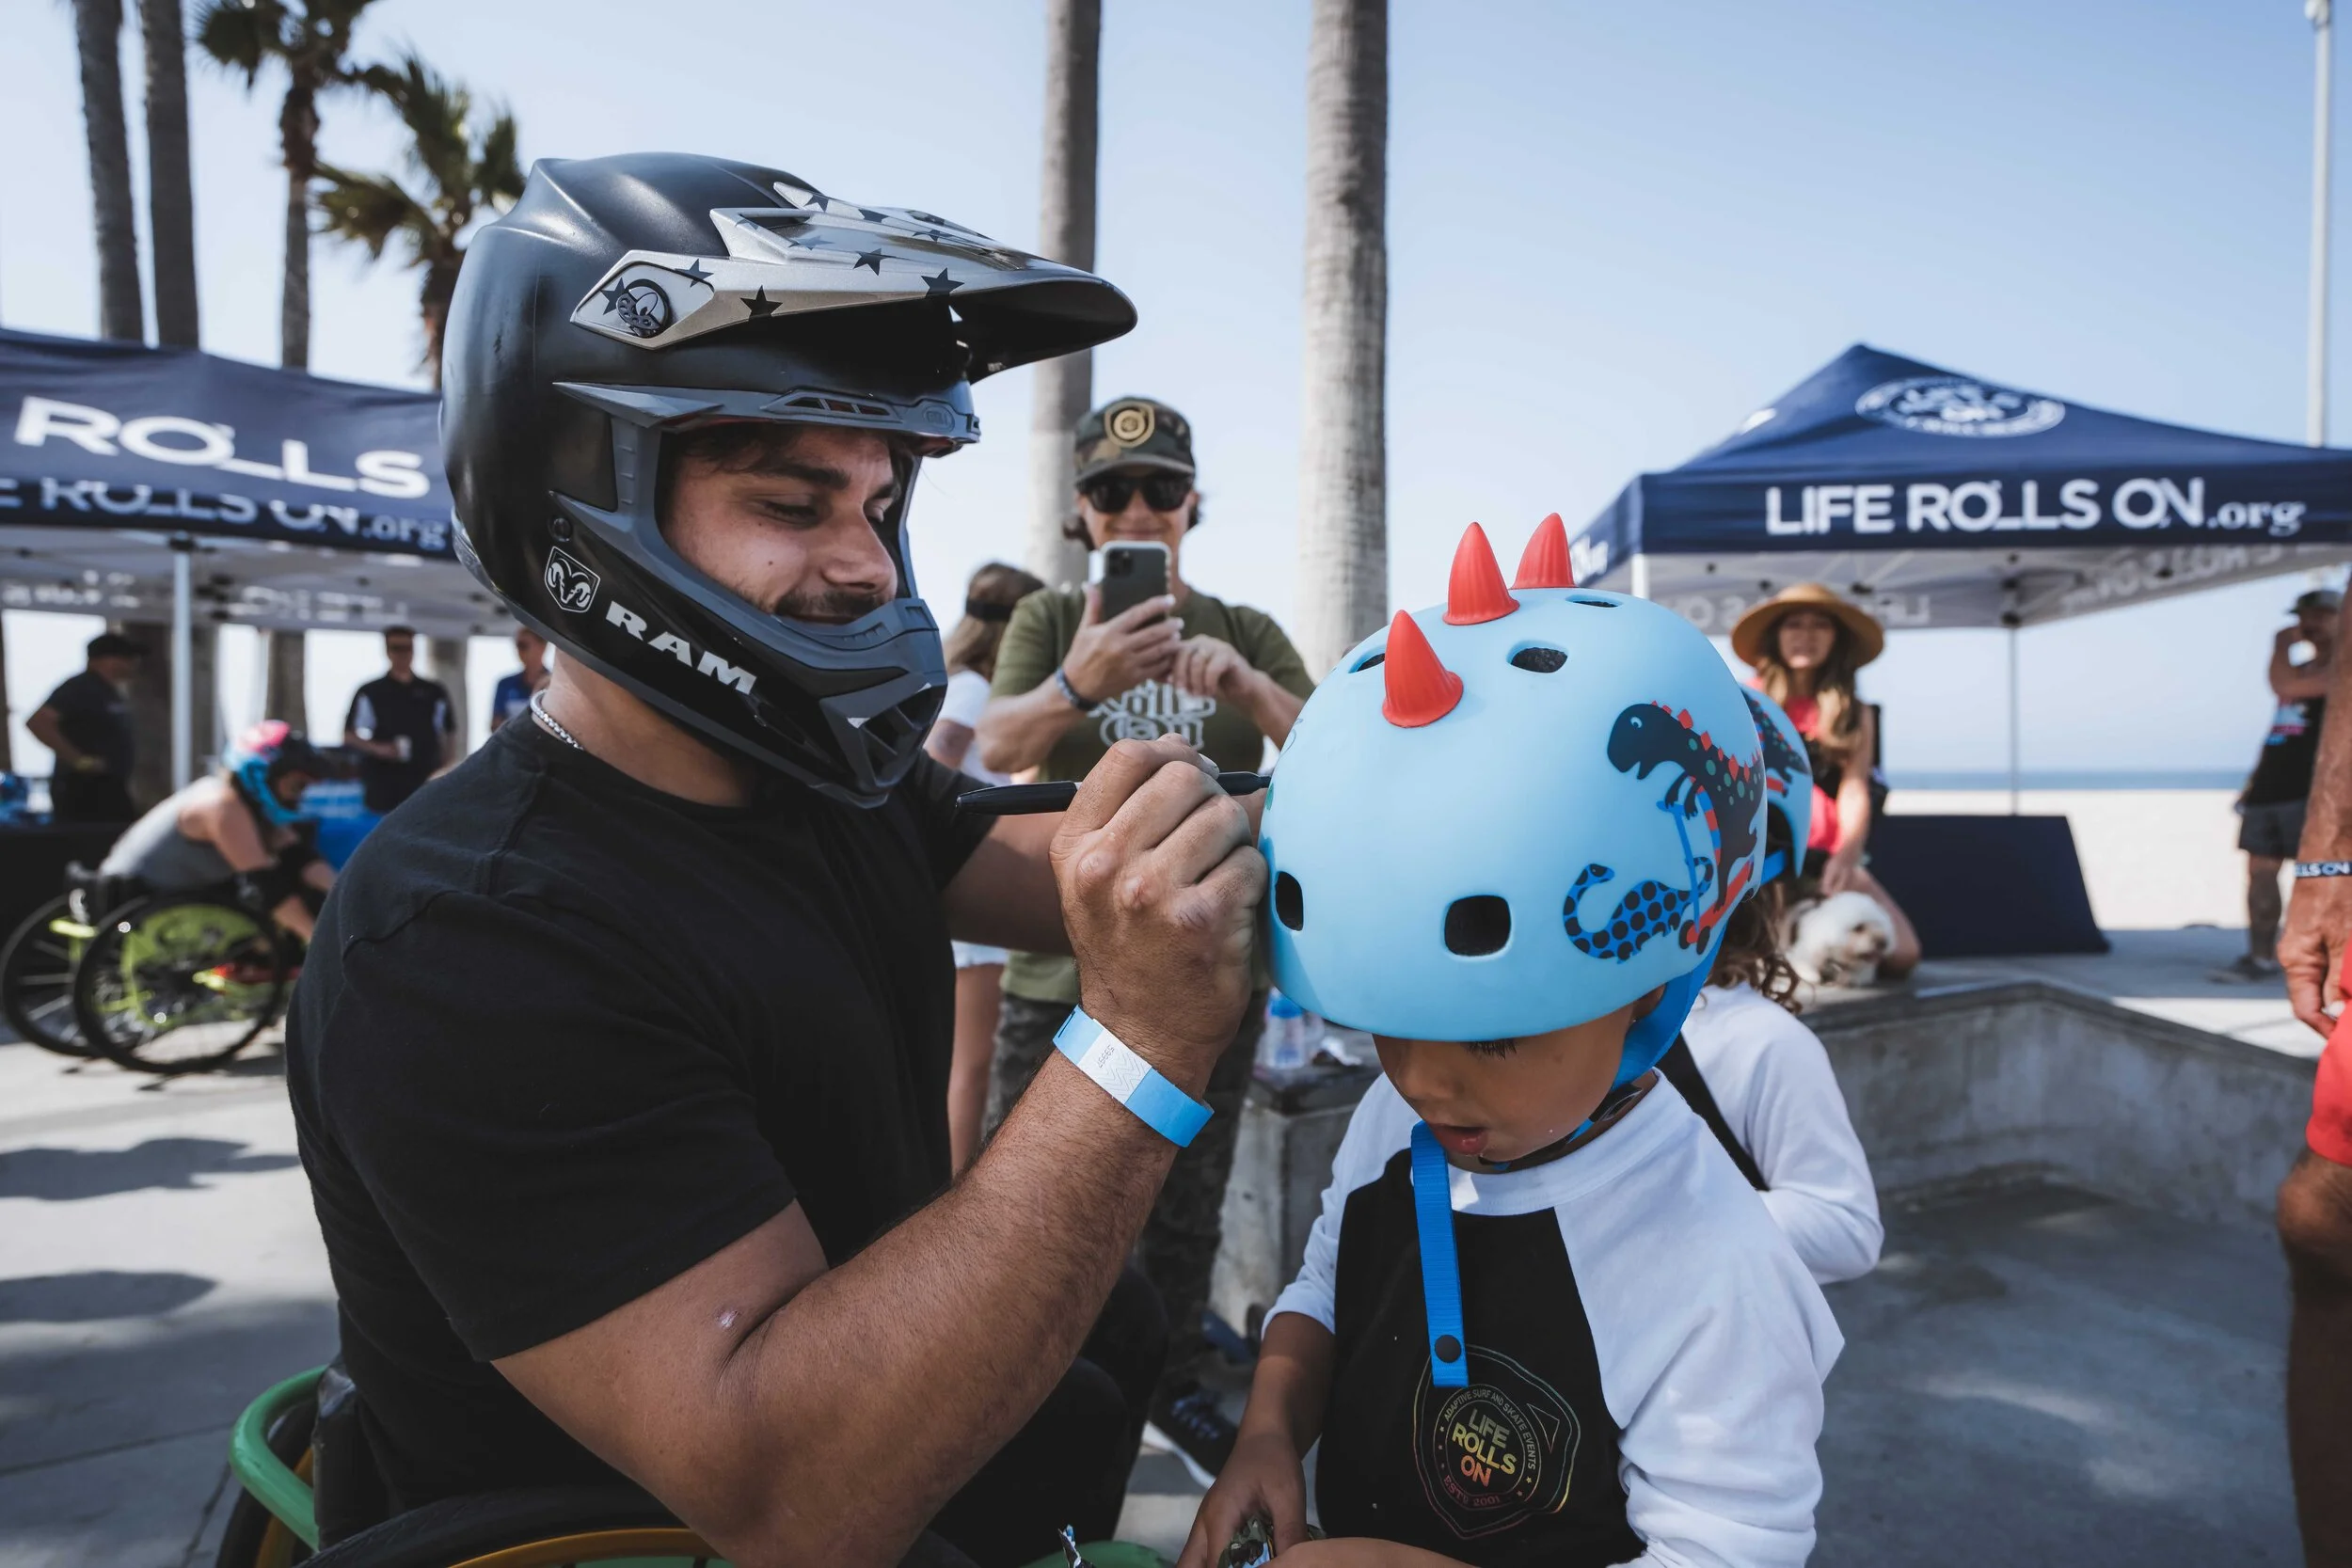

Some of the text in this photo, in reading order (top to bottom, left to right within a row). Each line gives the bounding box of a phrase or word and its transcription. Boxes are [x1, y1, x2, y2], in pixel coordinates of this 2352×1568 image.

[14, 396, 431, 499] ROLLS
[1765, 484, 1895, 534] LIFE
[1906, 478, 2103, 533] ROLLS
[605, 600, 757, 696] RAM
[1443, 1388, 1536, 1470] ADAPTIVE SURF AND SKATE EVENTS
[1452, 1421, 1518, 1475] ROLLS
[1469, 1408, 1510, 1449] LIFE
[1460, 1455, 1492, 1487] ON
[1472, 1495, 1501, 1506] 2001
